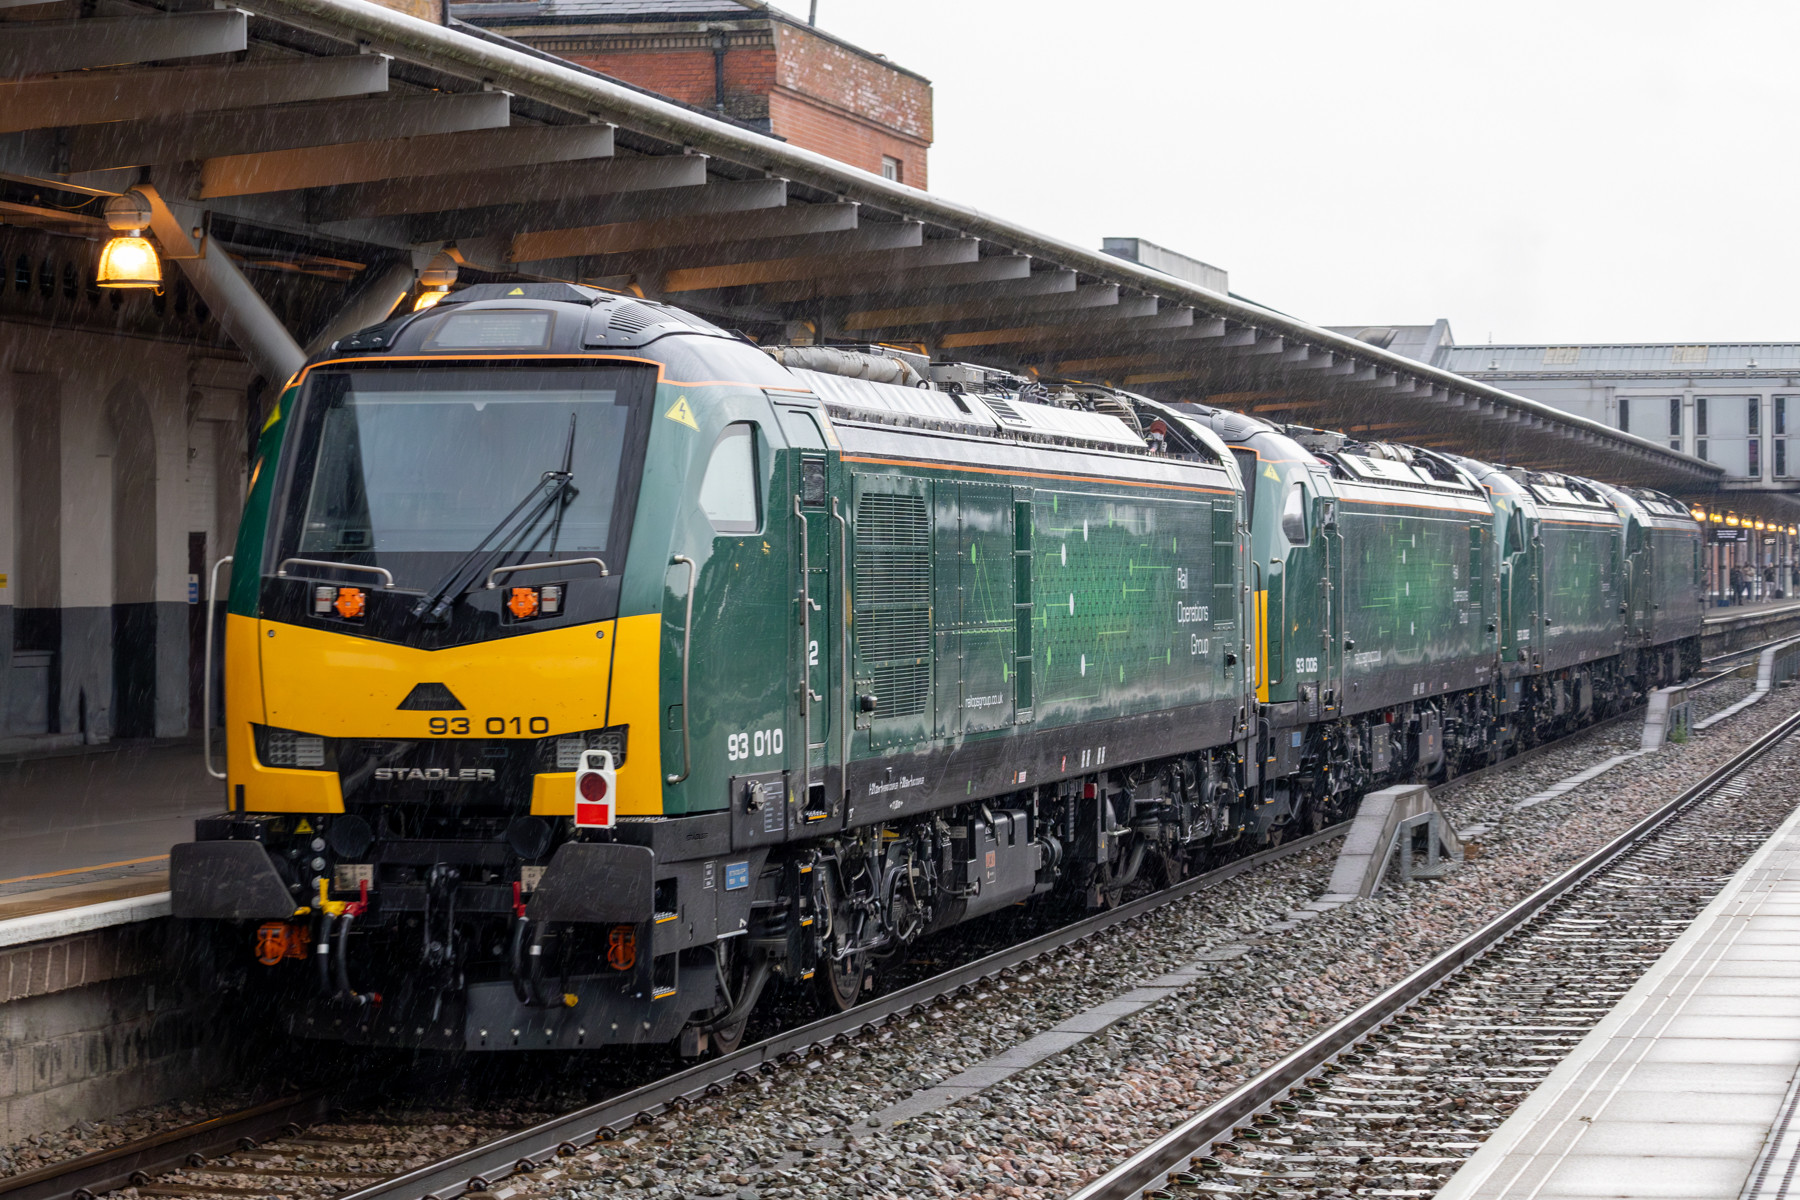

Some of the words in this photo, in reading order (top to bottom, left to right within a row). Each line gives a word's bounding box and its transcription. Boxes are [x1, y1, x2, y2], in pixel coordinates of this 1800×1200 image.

[1177, 567, 1189, 589] Rail
[1177, 600, 1209, 627] Operations
[808, 640, 819, 665] 2
[1190, 633, 1209, 659] Group
[1295, 657, 1304, 673] 93
[428, 717, 471, 735] 93
[486, 716, 549, 735] 010
[727, 733, 749, 761] 93
[753, 728, 783, 757] 010
[374, 767, 496, 782] STADLER
